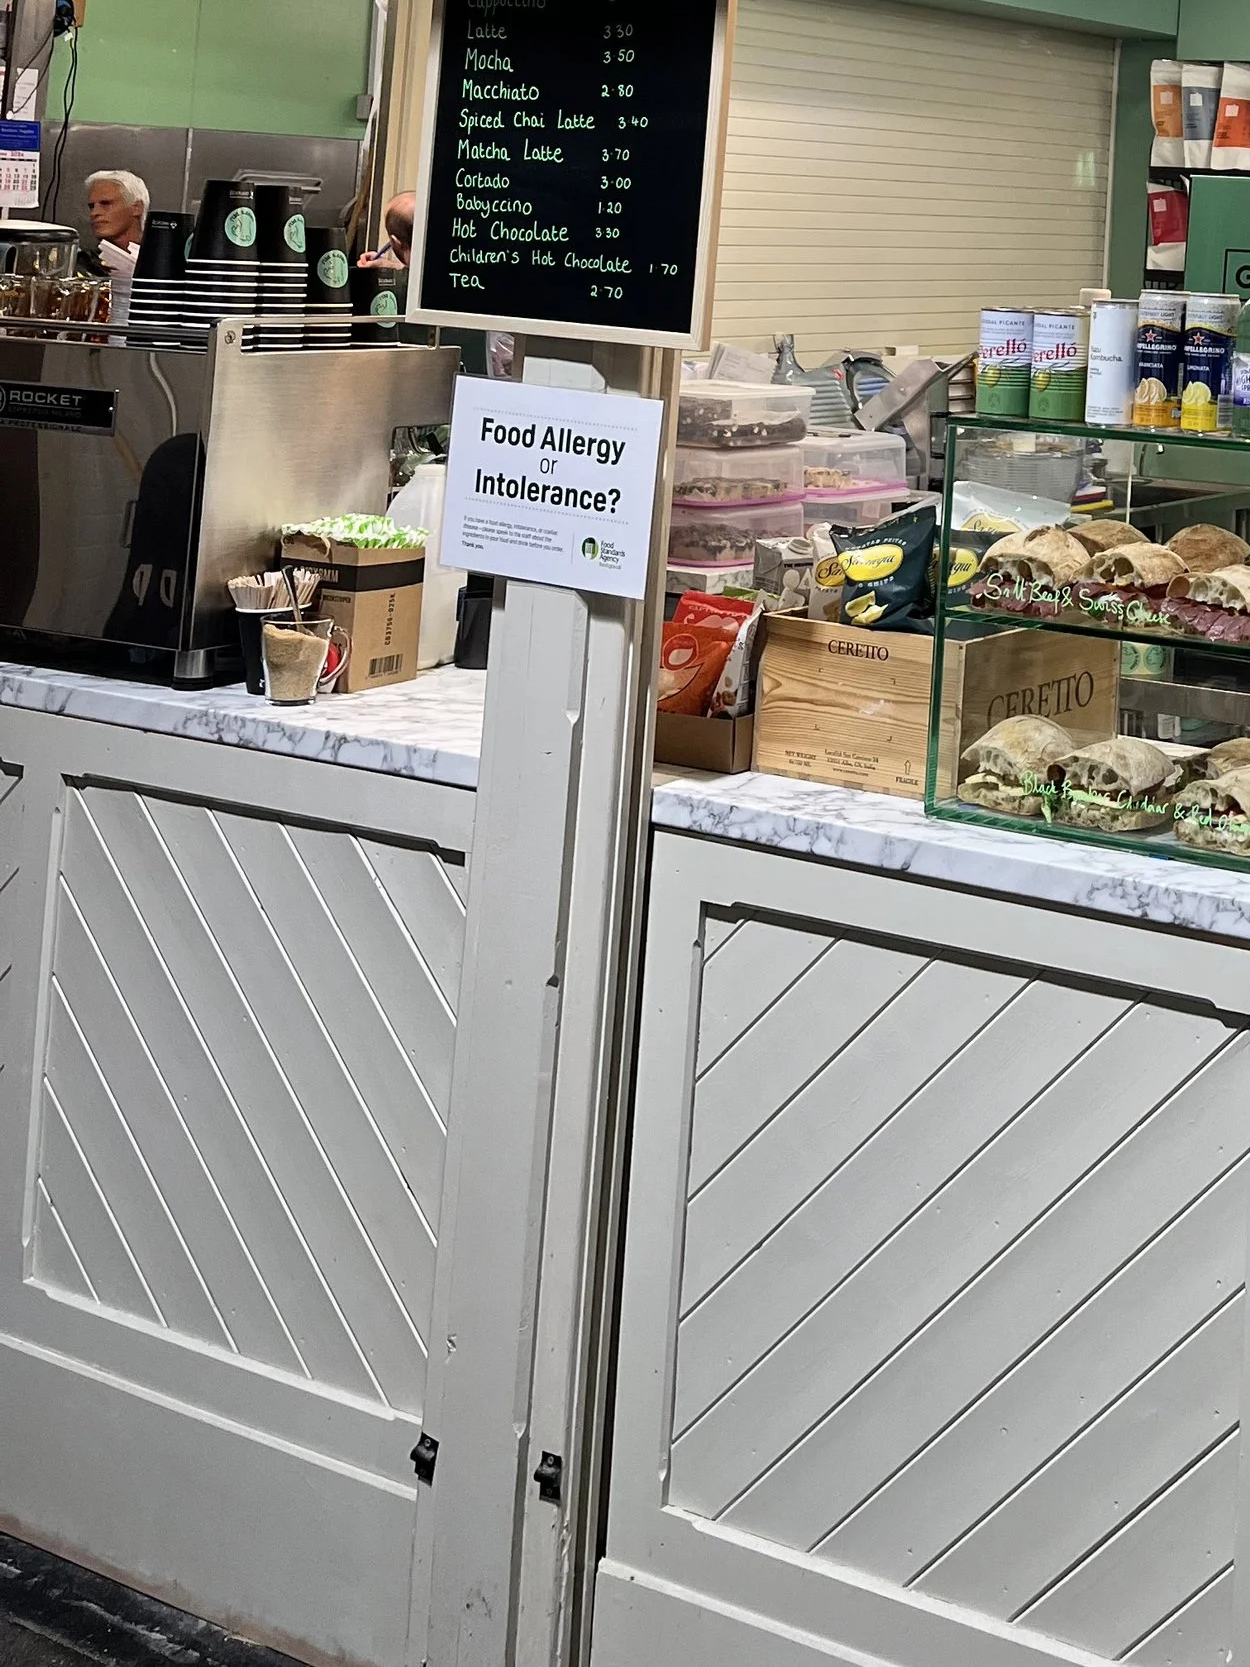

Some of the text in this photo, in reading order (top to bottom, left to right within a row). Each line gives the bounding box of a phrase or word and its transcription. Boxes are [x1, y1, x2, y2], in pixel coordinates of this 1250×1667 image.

[467, 20, 507, 39] Latte
[464, 48, 514, 72] Mocha
[462, 79, 539, 101] Macchiato
[459, 109, 505, 134] Spiced
[514, 111, 545, 128] Chai
[557, 110, 595, 129] Latte
[457, 139, 510, 160] Matcha
[523, 139, 564, 163] Latte
[456, 168, 510, 188] Cortado
[456, 193, 532, 218] Babyccino
[452, 218, 476, 238] Hot
[490, 221, 569, 241] Chocolate
[450, 248, 519, 263] Children's
[532, 250, 555, 266] Hot
[564, 253, 632, 273] Chocolate
[449, 273, 485, 289] Tea
[980, 338, 1026, 358] erelló
[10, 390, 82, 406] ROCKET
[480, 417, 625, 465] Food Allergy
[540, 458, 558, 474] or
[475, 468, 621, 514] Intolerance?
[1061, 586, 1074, 606] &
[828, 639, 889, 661] CERETTO
[1174, 803, 1186, 819] &
